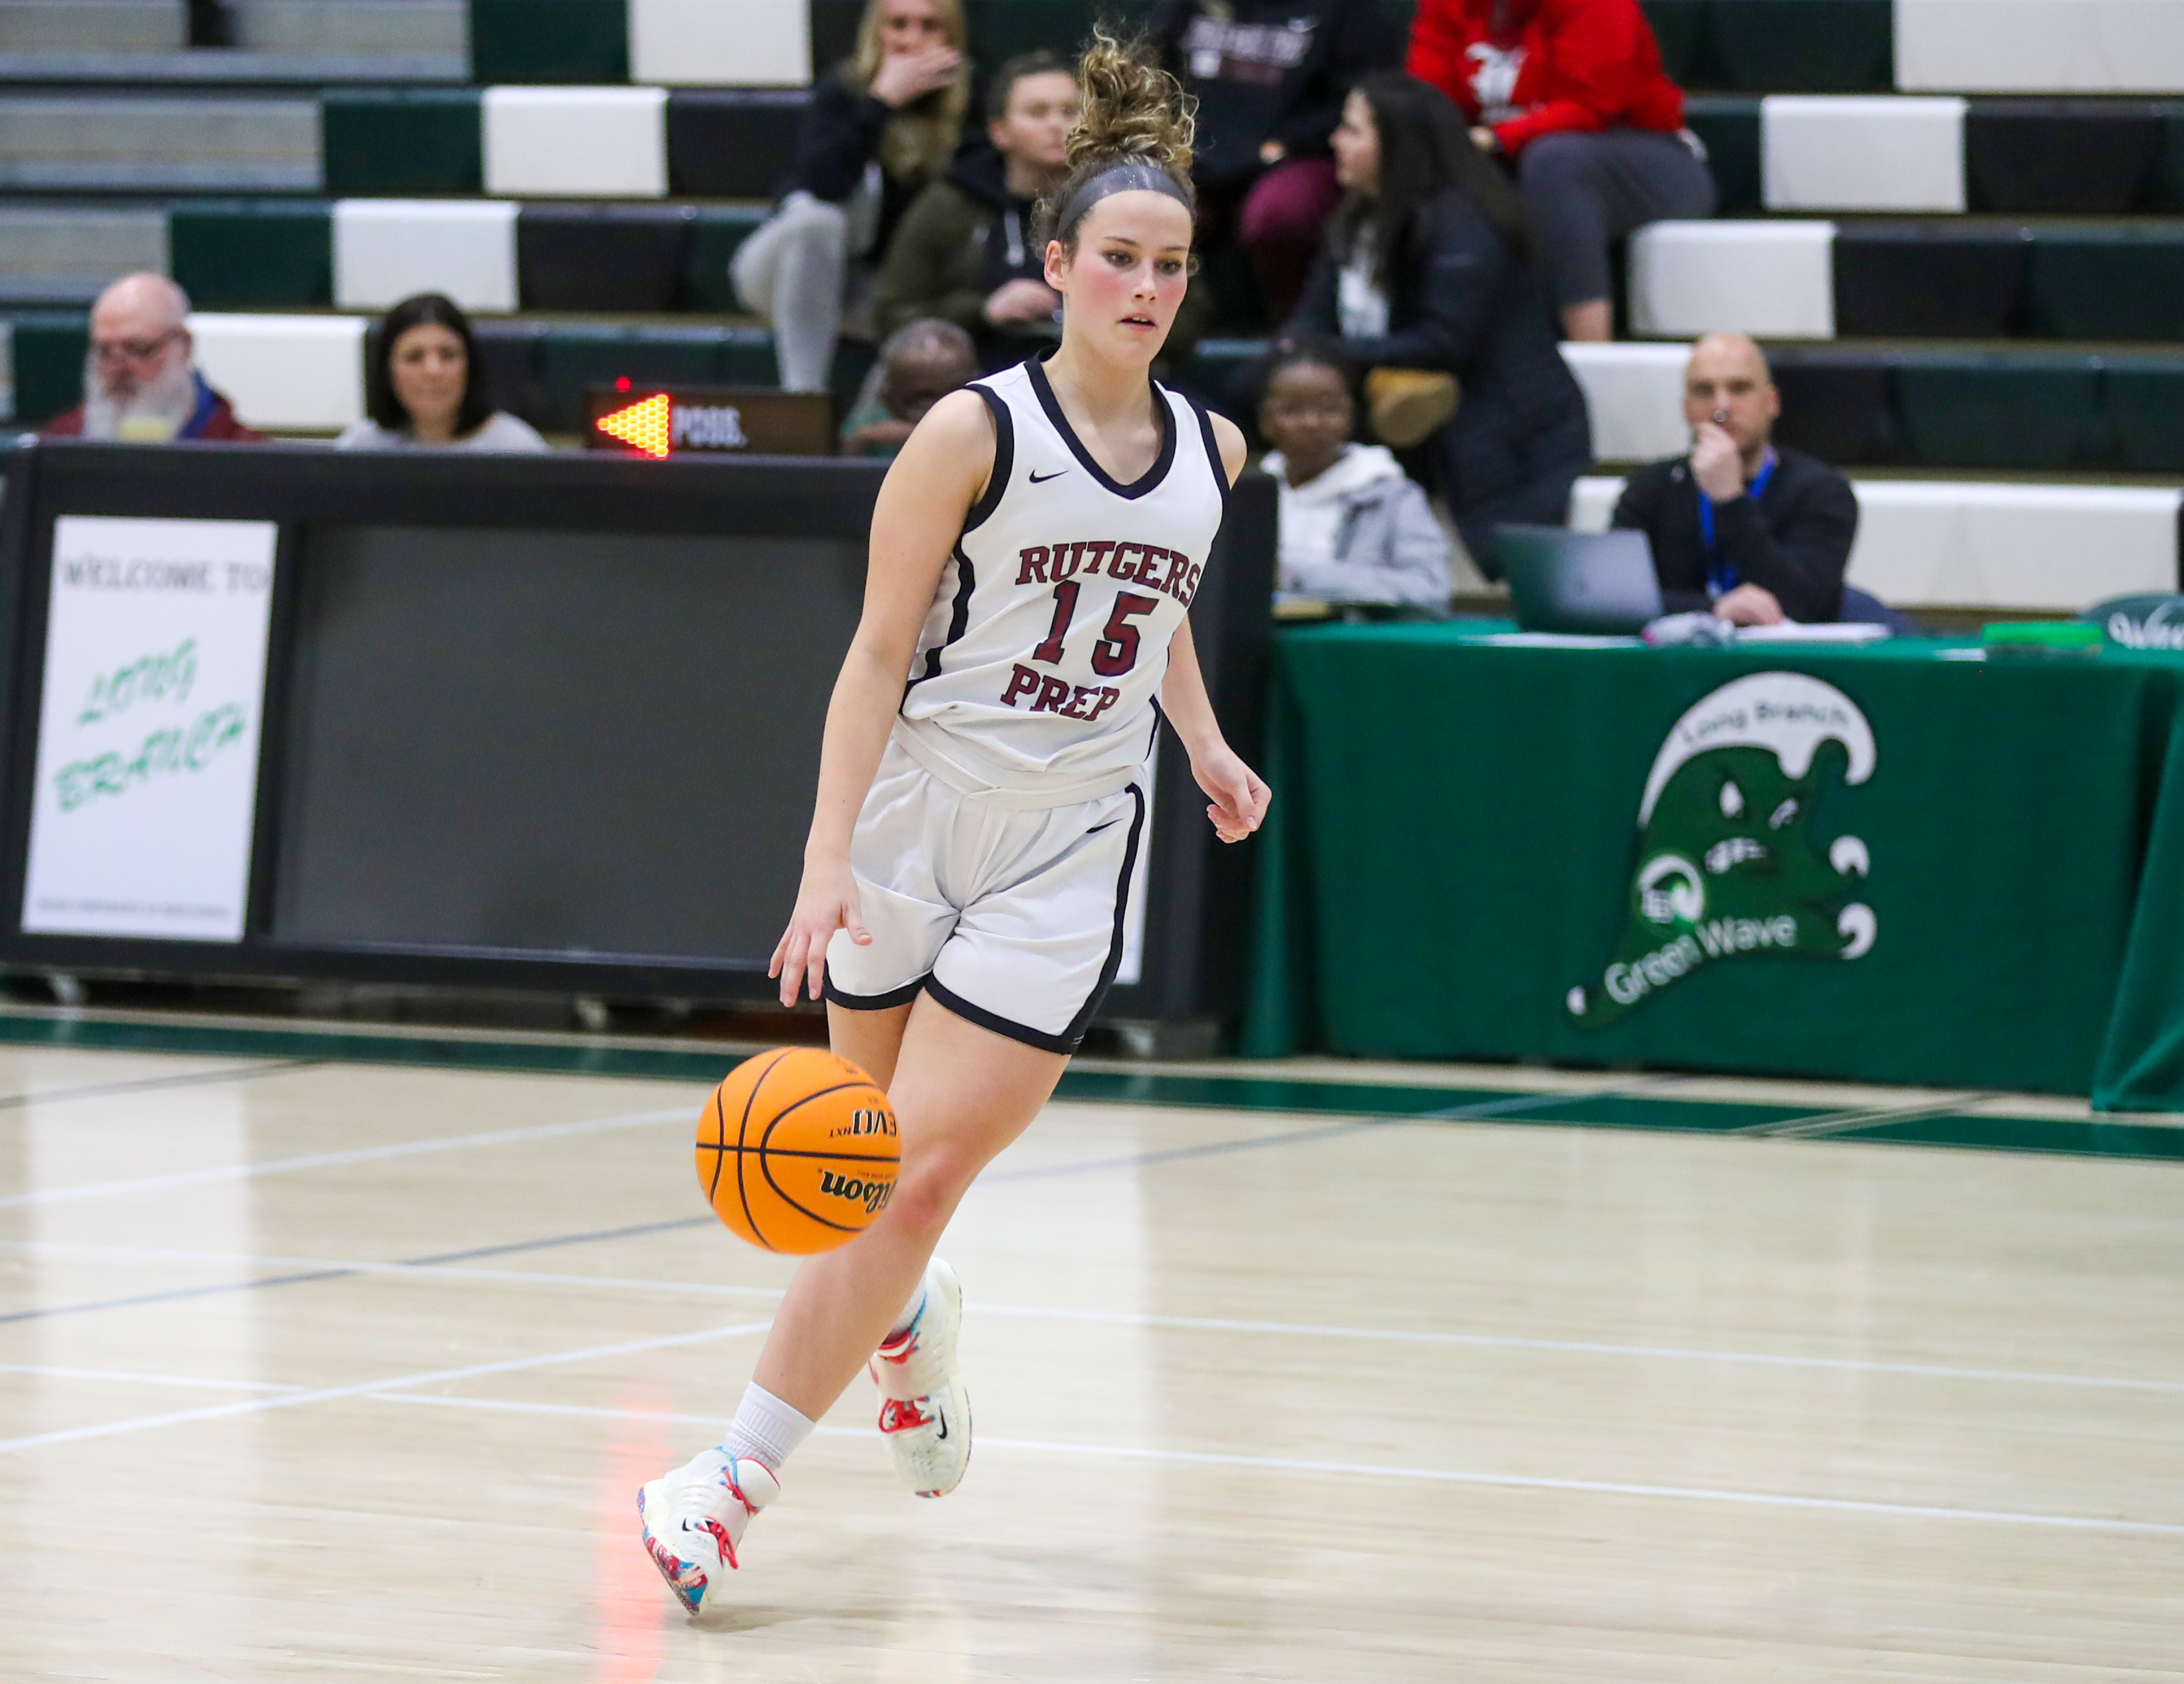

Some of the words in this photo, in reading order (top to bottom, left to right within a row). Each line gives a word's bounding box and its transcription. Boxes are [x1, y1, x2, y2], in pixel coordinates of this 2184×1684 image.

[63, 554, 210, 590] WELCOME
[226, 559, 272, 592] TO
[1015, 541, 1201, 608] RUTGERS
[1032, 579, 1160, 677] 15
[76, 637, 197, 727] LONG
[1000, 663, 1120, 722] PREP
[54, 703, 247, 812] BRANCH
[1603, 934, 1703, 1005] Green
[1693, 914, 1797, 958] Wave
[828, 1126, 852, 1138] NXT
[852, 1109, 897, 1136] EVO
